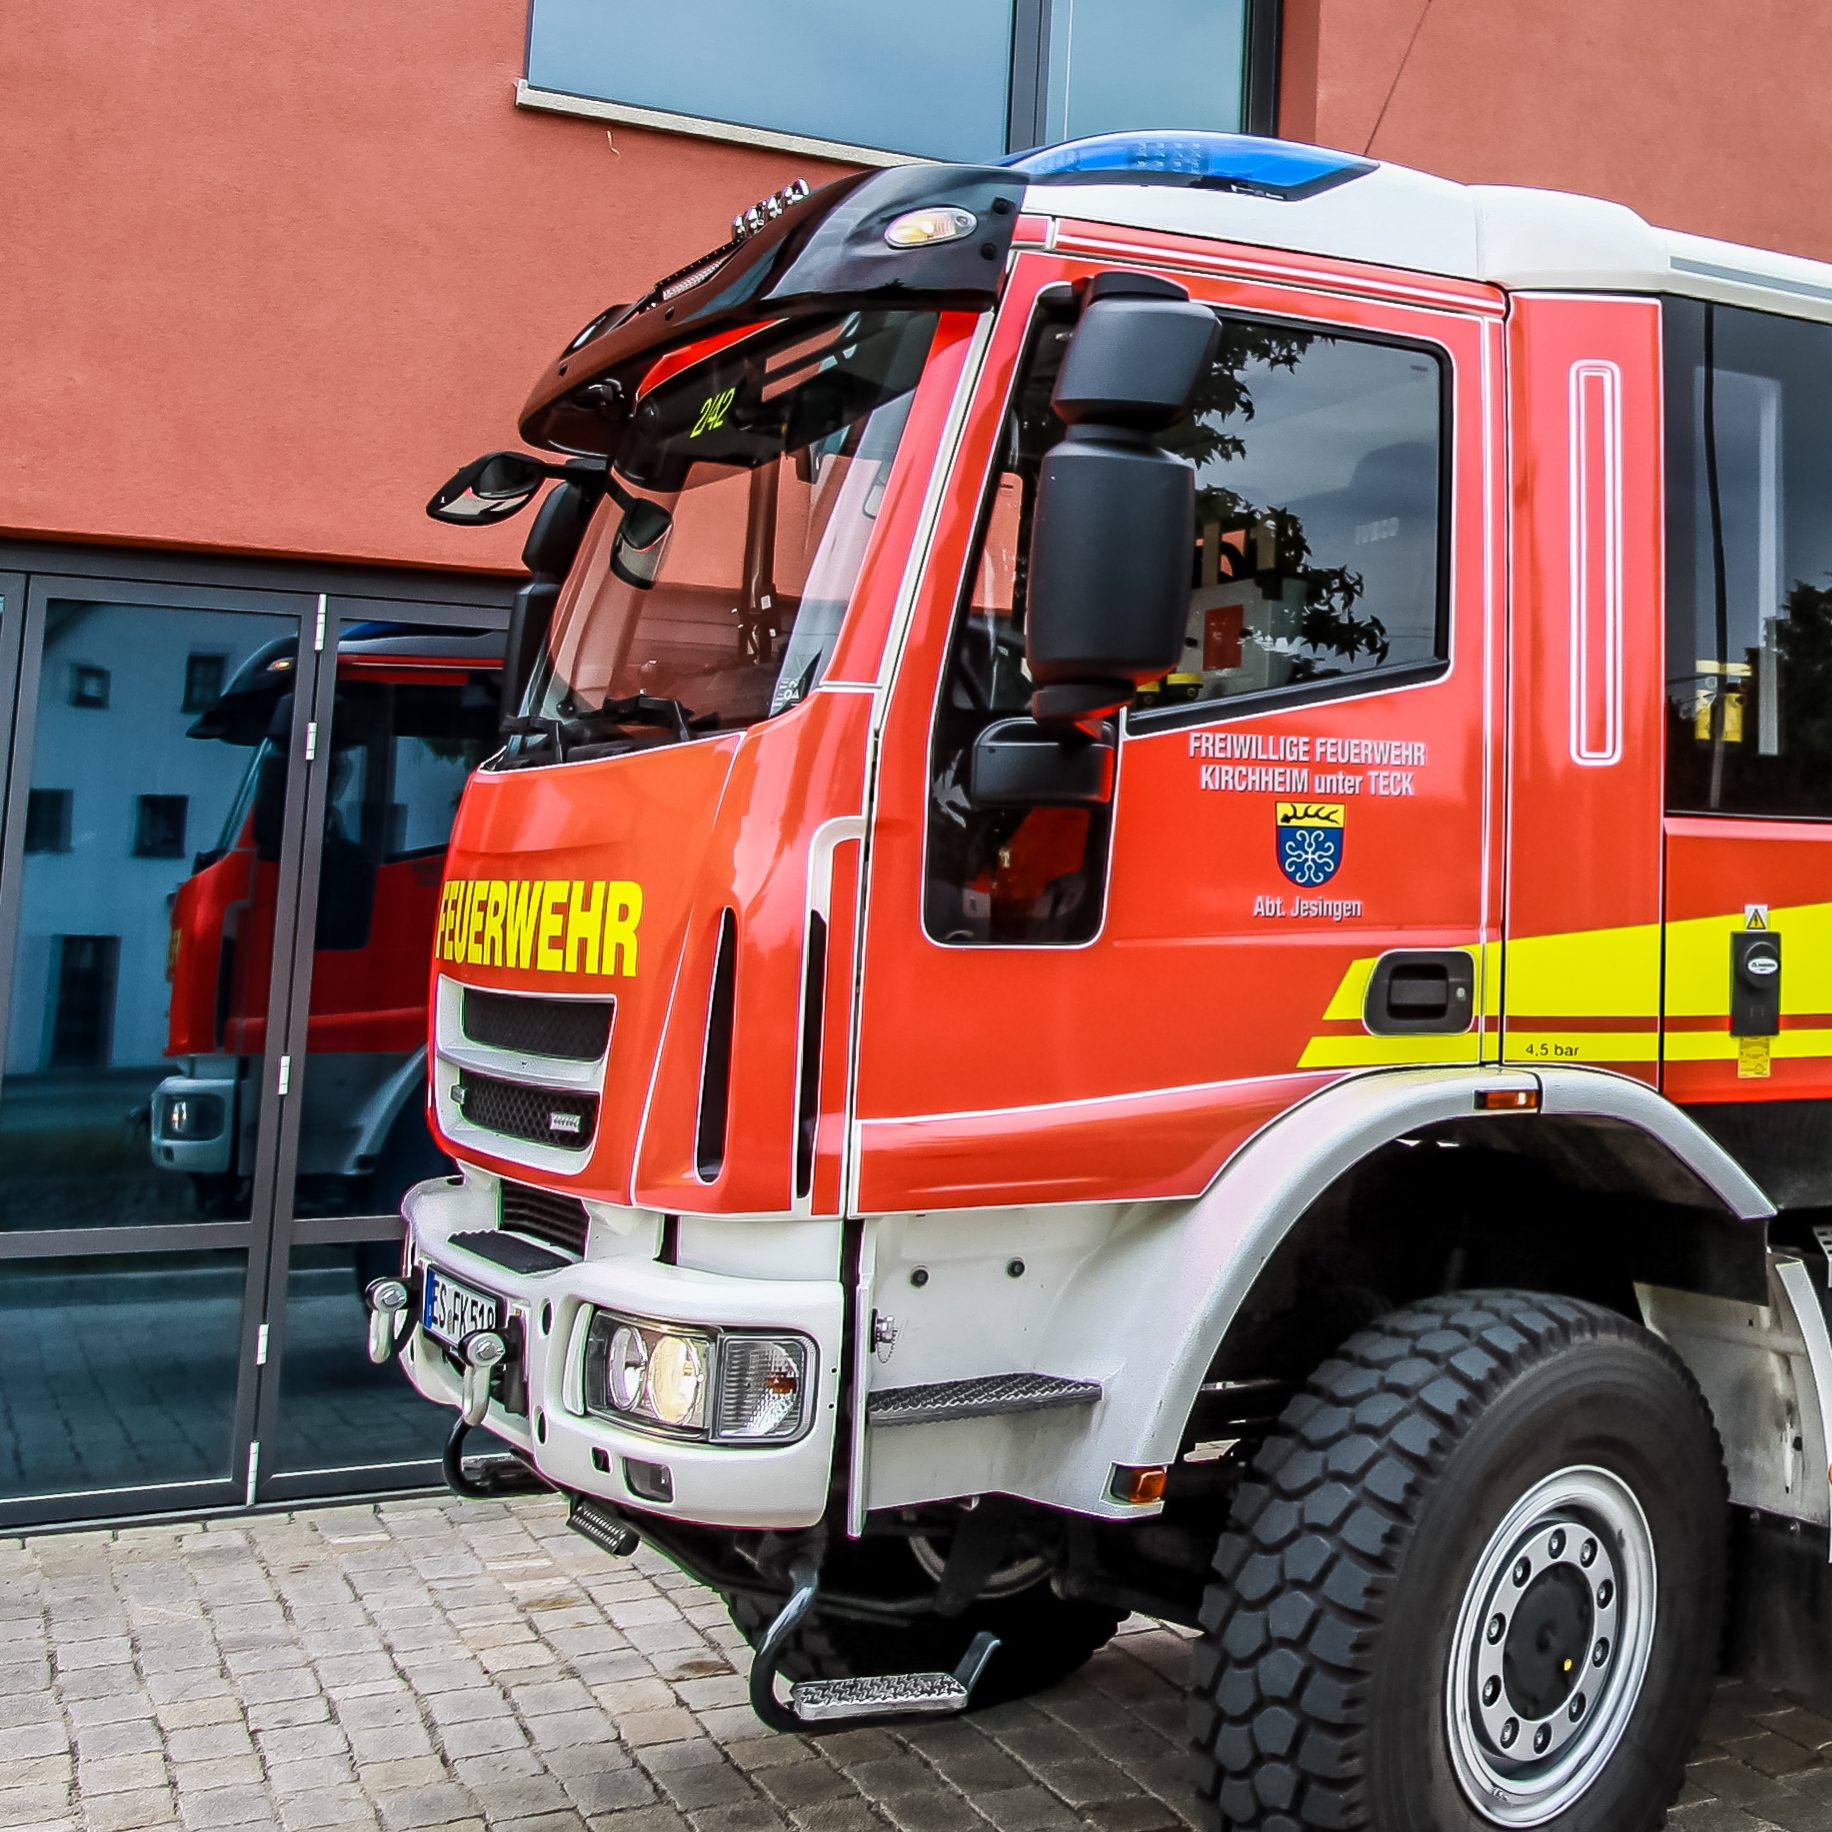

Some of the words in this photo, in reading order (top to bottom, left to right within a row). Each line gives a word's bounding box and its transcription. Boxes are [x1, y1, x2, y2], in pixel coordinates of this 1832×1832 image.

[689, 387, 736, 438] 242
[1188, 732, 1310, 762] FREIWILLIGE
[1315, 737, 1427, 766] FEUERWEHR
[1200, 765, 1309, 793] KIRCHHEIM
[1314, 773, 1363, 795] unter
[1367, 770, 1415, 796] TECK
[1252, 895, 1287, 918] Abt.
[1290, 896, 1362, 921] Jesingen
[435, 880, 644, 977] FEUERWEHR
[1554, 1043, 1580, 1056] bar
[431, 1279, 447, 1329] ES
[453, 1290, 469, 1338] FK
